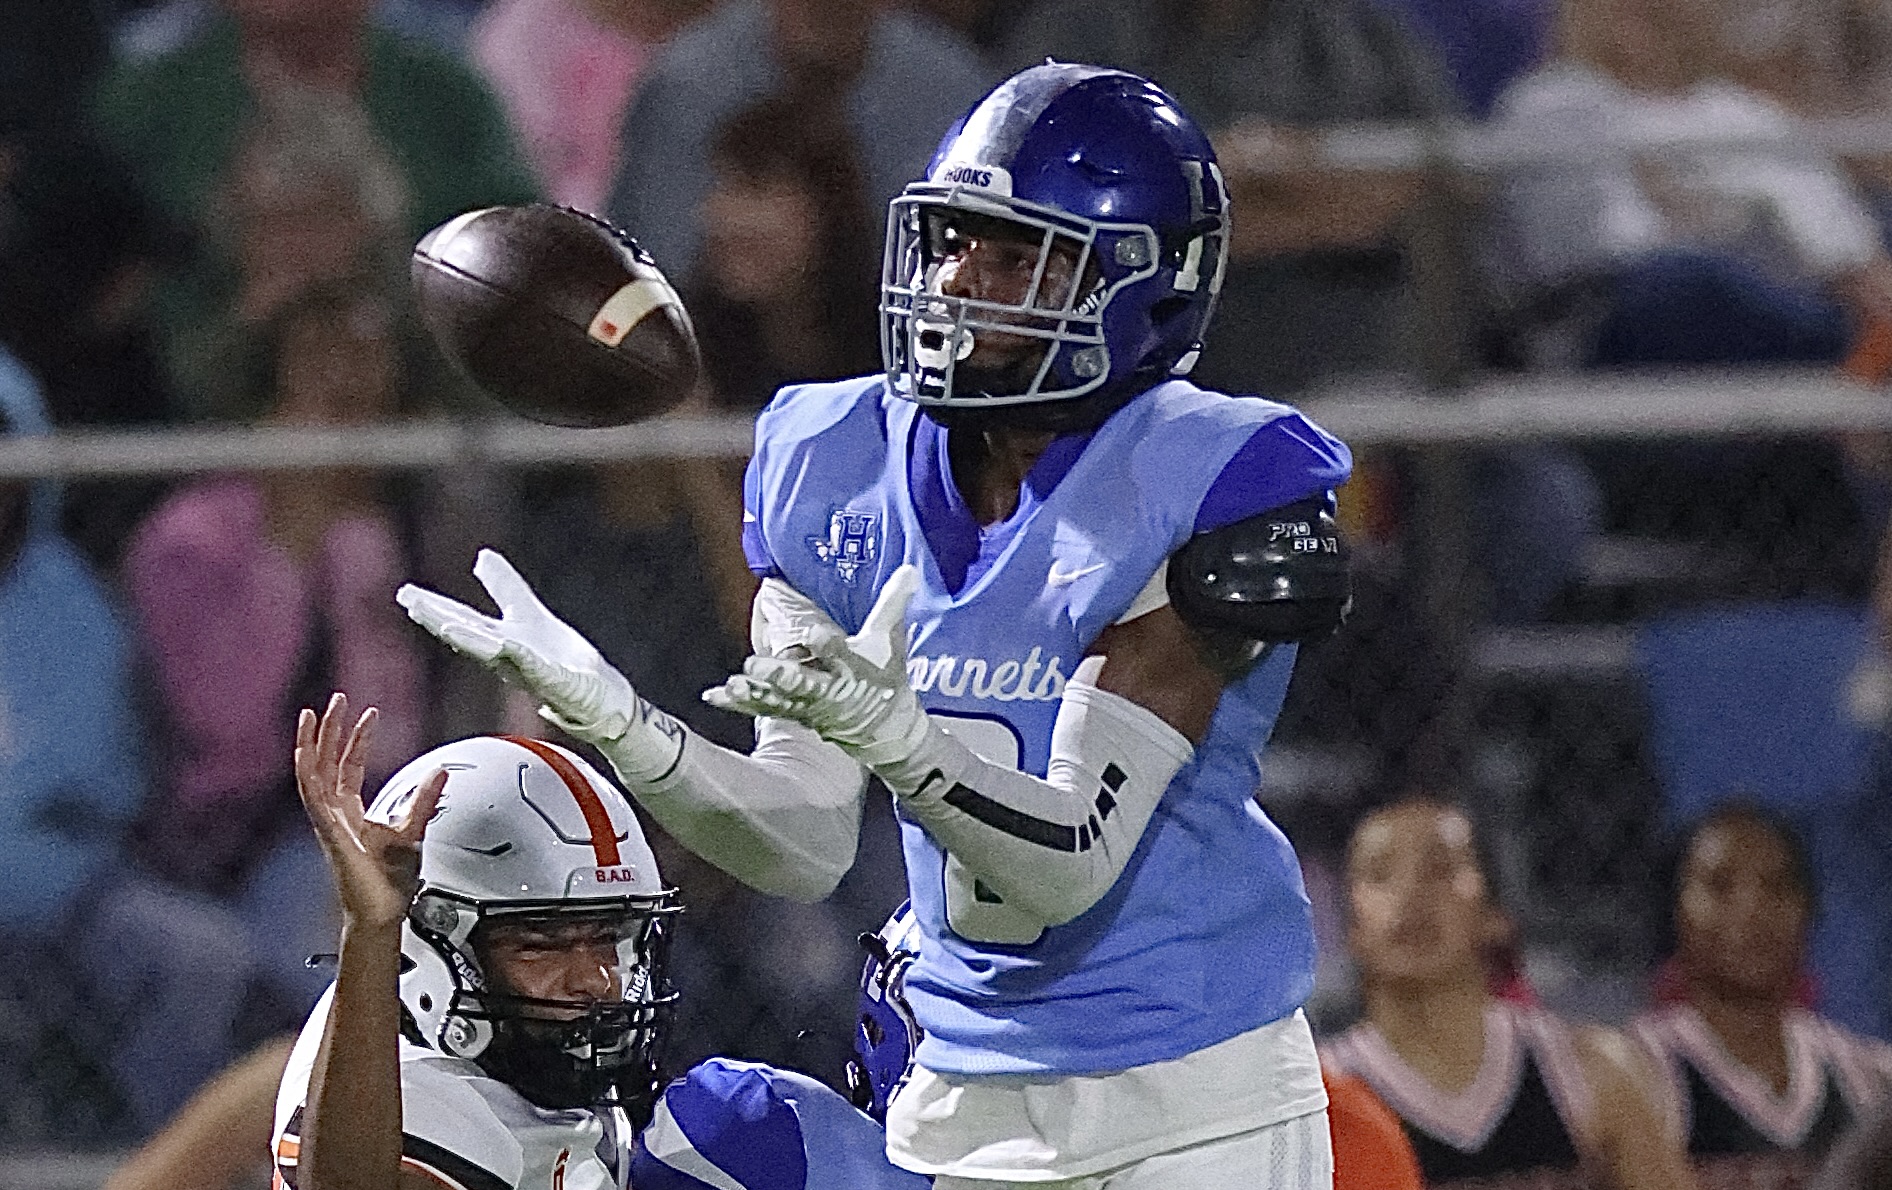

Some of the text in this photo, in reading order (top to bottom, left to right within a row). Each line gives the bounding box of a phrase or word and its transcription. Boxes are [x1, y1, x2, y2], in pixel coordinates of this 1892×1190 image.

[944, 166, 994, 188] HOOKS
[906, 645, 1067, 702] ornets
[595, 869, 635, 883] B.A.D.
